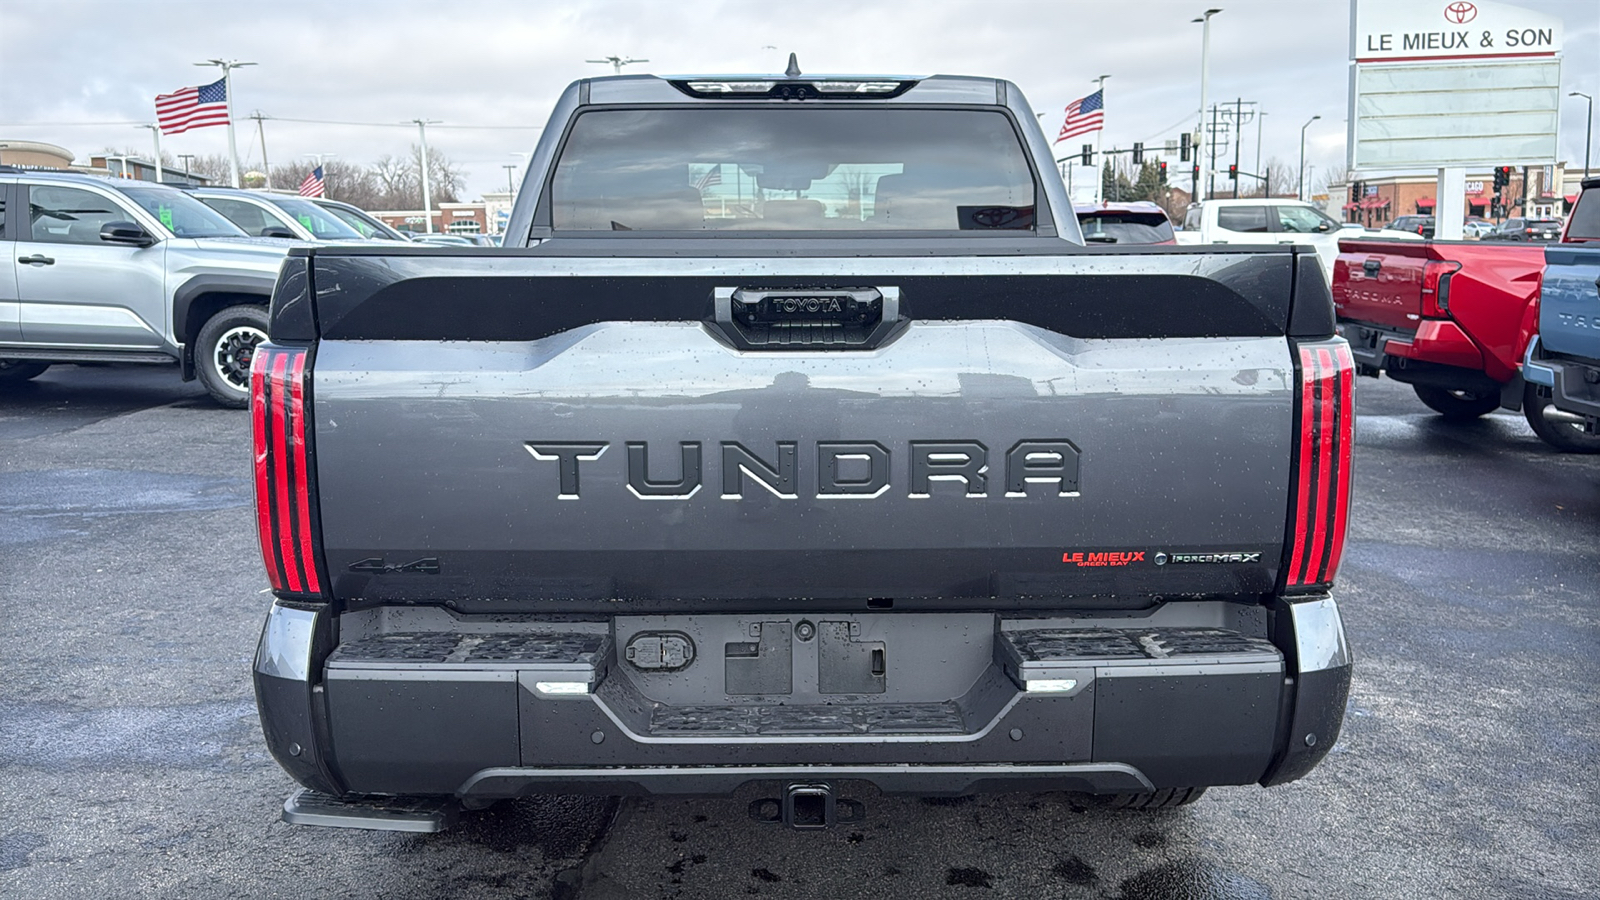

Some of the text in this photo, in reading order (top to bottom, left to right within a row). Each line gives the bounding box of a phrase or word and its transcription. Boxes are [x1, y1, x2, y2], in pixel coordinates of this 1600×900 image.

[1367, 28, 1552, 51] LE MIEUX & SON
[1343, 288, 1403, 305] TACOMA
[772, 298, 842, 313] TOYOTA
[523, 438, 1082, 501] TUNDRA
[1062, 551, 1145, 562] LE MIEUX
